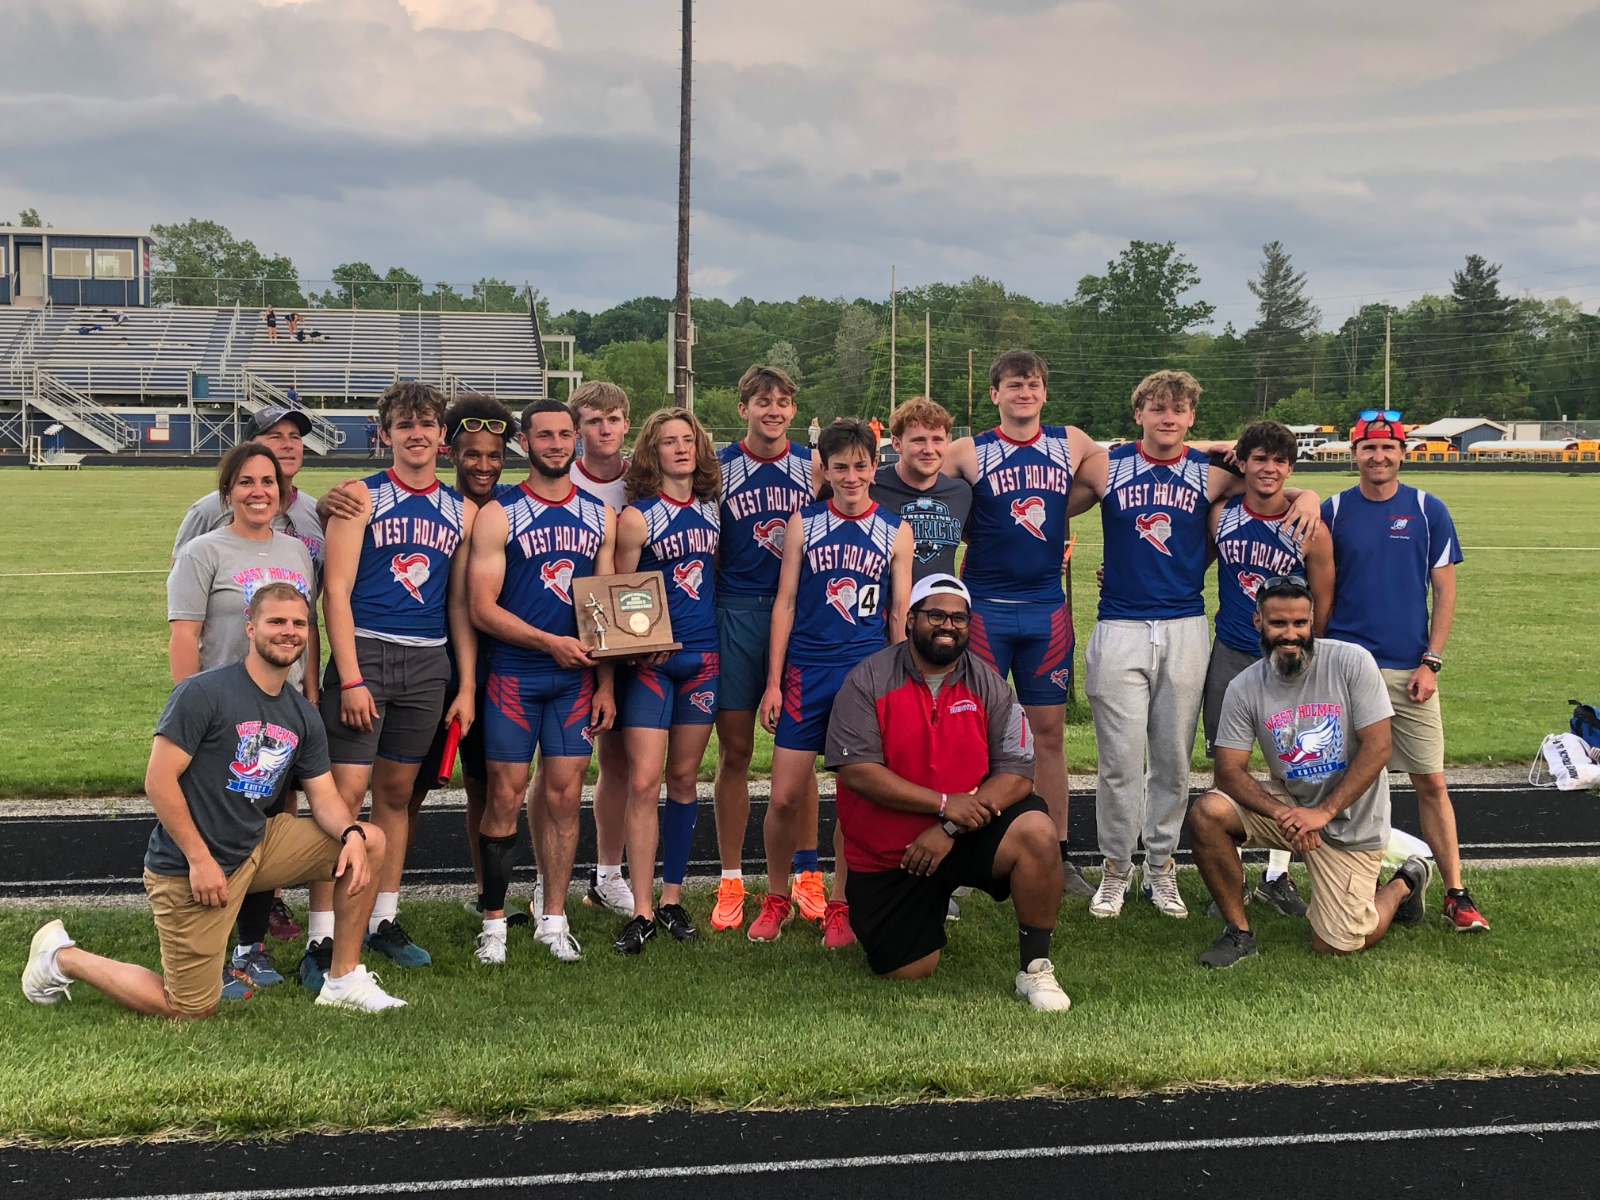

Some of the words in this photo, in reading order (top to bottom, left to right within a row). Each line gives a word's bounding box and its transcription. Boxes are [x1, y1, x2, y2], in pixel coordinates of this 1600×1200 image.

[987, 466, 1021, 497] WEST
[1024, 464, 1068, 496] HOLMES
[726, 488, 762, 521] WEST
[1116, 483, 1150, 511] WEST
[1152, 483, 1199, 514] HOLMES
[371, 517, 409, 549] WEST
[412, 517, 460, 559] HOLMES
[517, 527, 552, 559] WEST
[554, 526, 600, 561] HOLMES
[651, 531, 685, 561] WEST
[686, 528, 719, 555] HOLME
[910, 518, 961, 541] TRICTS
[807, 544, 840, 575] WEST
[841, 544, 887, 582] HOLMES
[1218, 540, 1248, 565] WEST
[1250, 541, 1297, 576] HOLMES
[232, 567, 263, 585] WEST
[861, 587, 876, 614] 4
[1262, 709, 1294, 731] WEST
[1297, 703, 1342, 718] HOLMES
[236, 720, 262, 738] WEST
[264, 722, 299, 748] HOLMES
